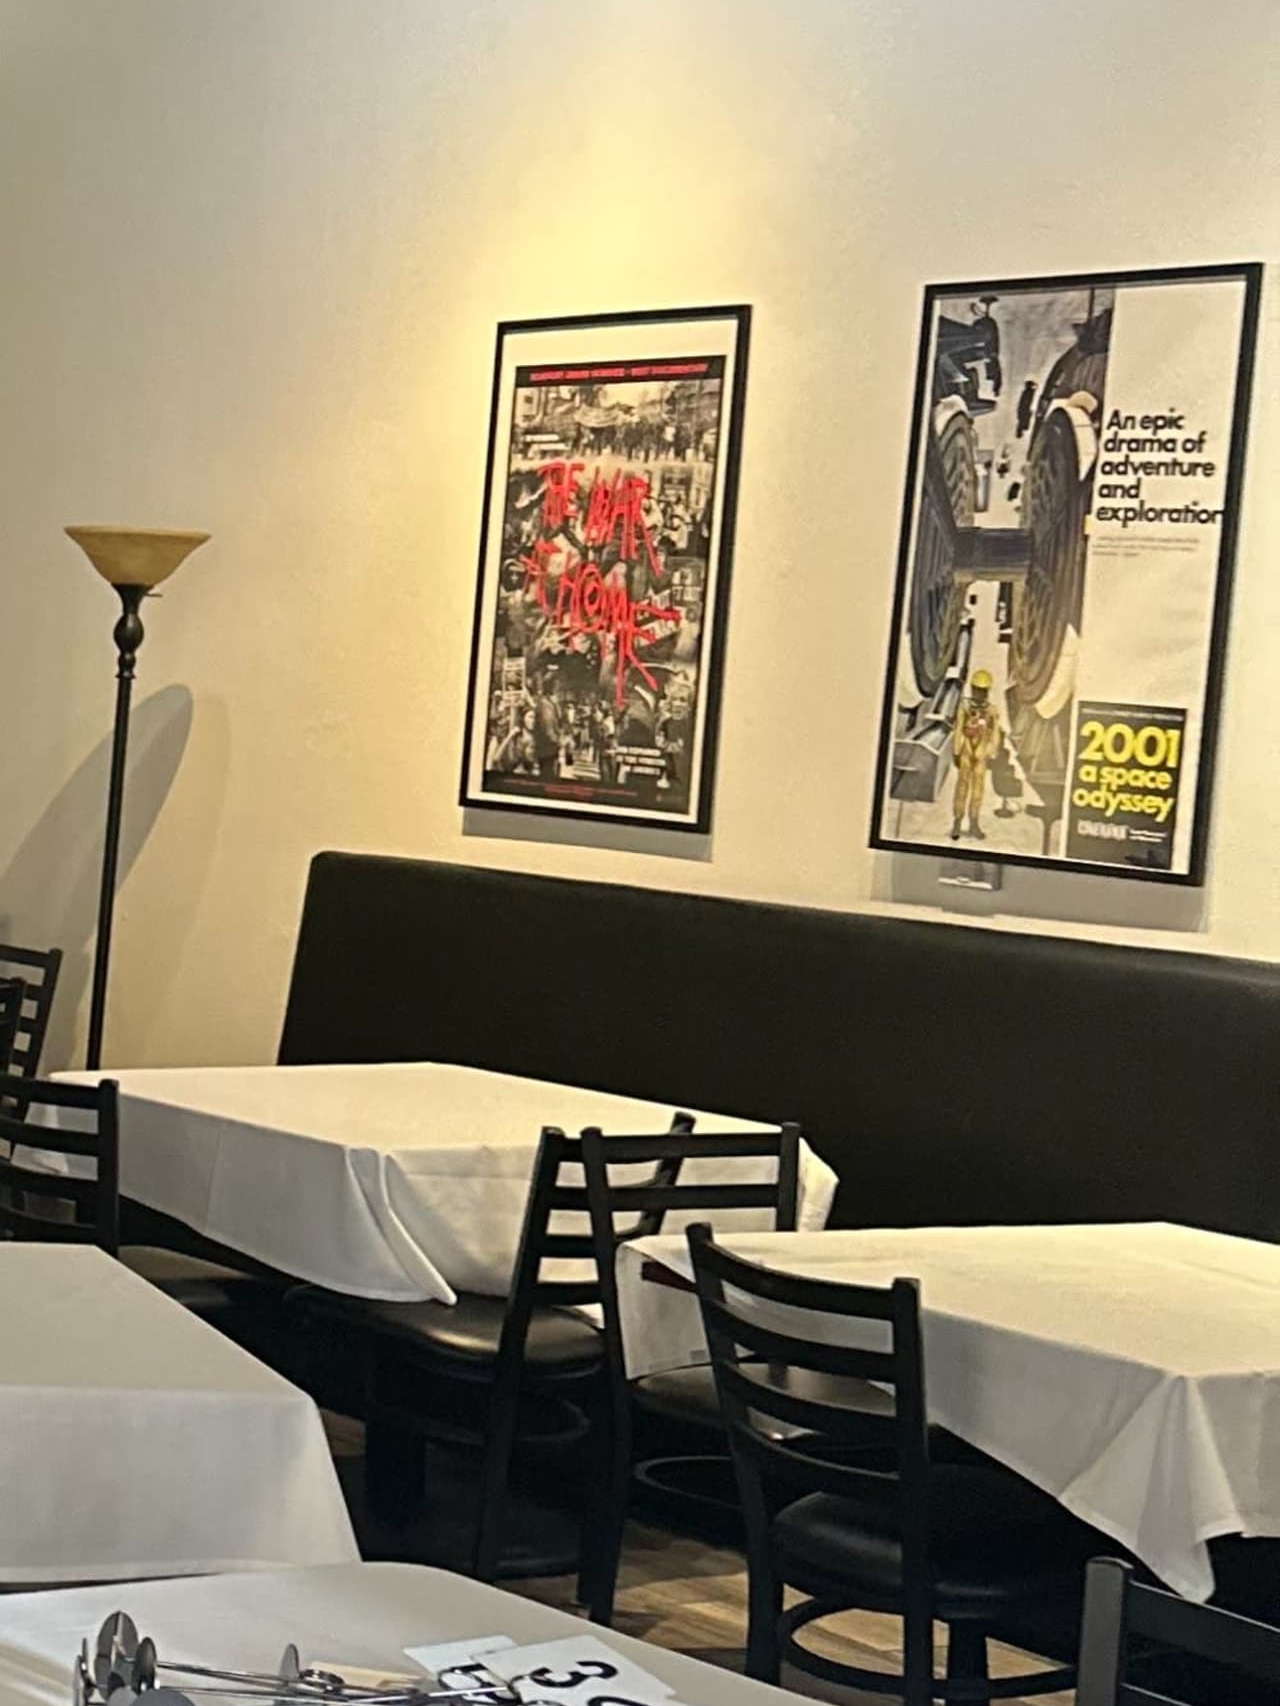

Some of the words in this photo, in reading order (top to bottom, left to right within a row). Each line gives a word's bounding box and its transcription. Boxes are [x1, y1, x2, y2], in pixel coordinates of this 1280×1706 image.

[1106, 409, 1136, 430] An
[1139, 407, 1185, 436] epic
[1103, 431, 1178, 453] drama
[1181, 431, 1207, 453] of
[1100, 454, 1216, 477] adventure
[1098, 477, 1142, 499] and
[1078, 720, 1181, 768] 2001
[1079, 764, 1098, 783] a
[1099, 766, 1172, 791] space
[1071, 784, 1175, 823] odyssey
[529, 1660, 619, 1689] 3
